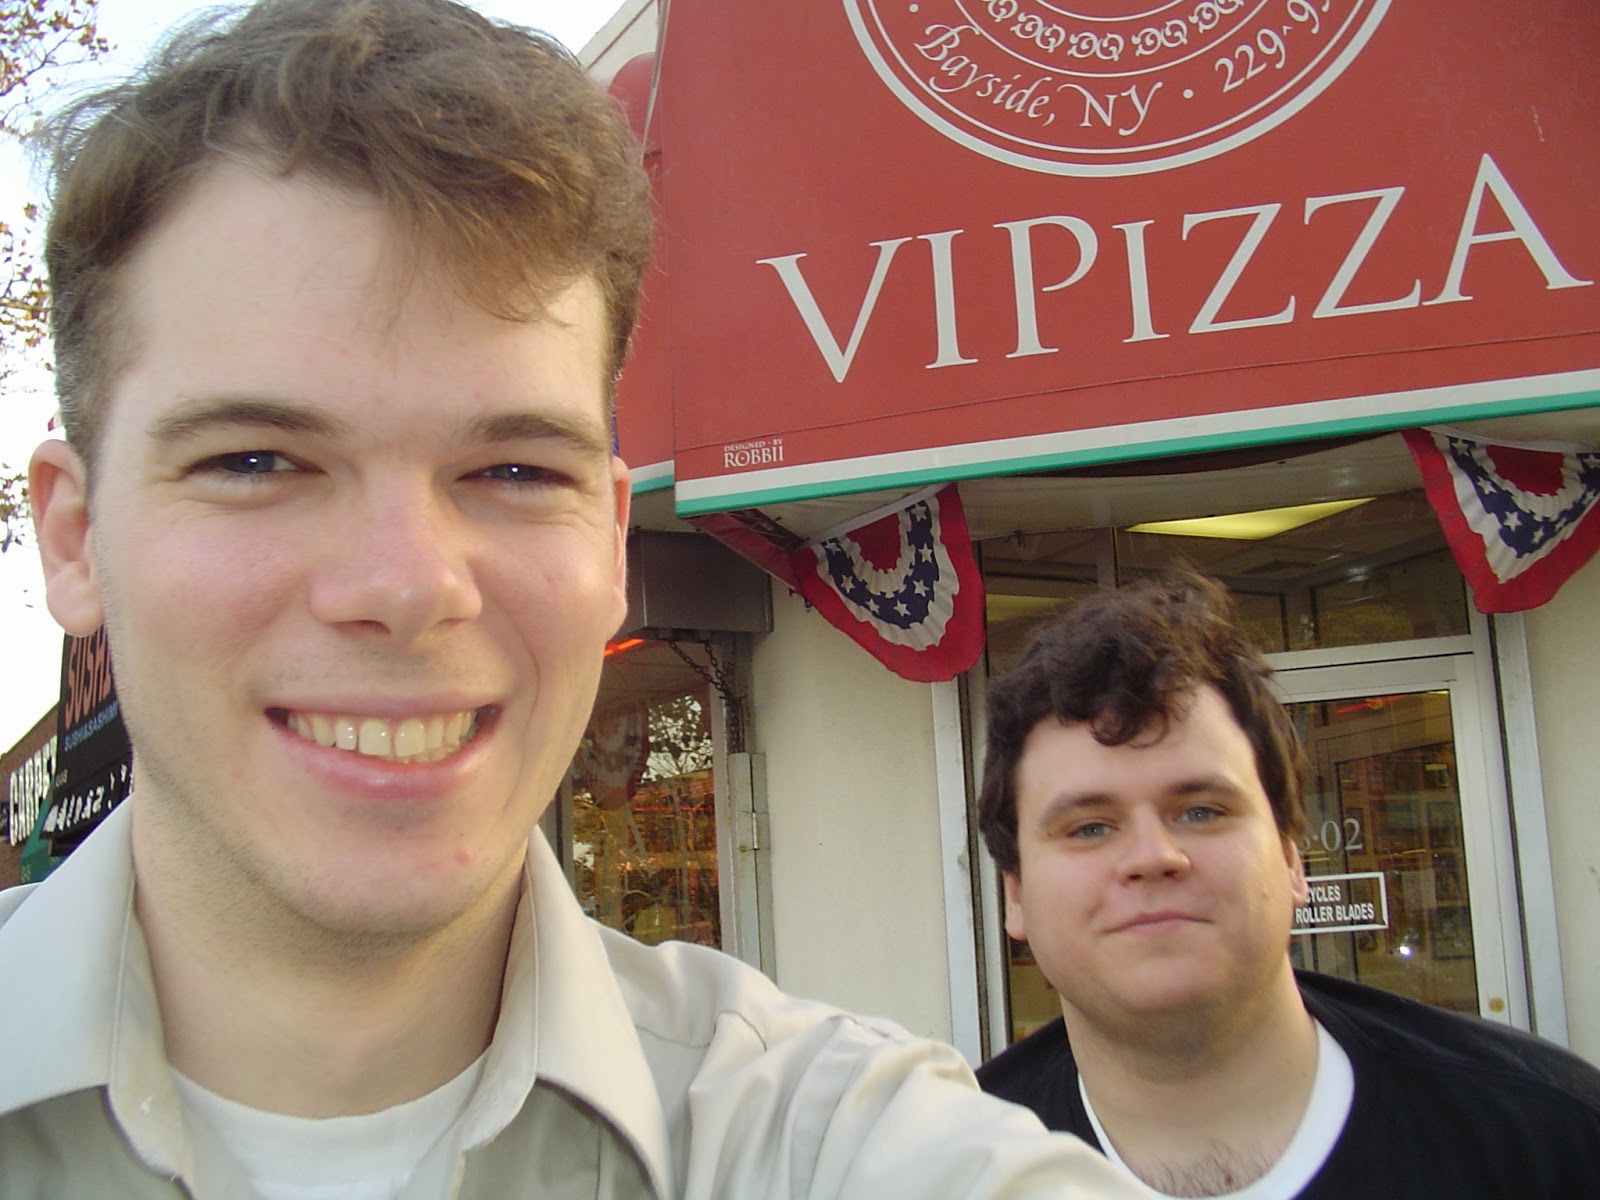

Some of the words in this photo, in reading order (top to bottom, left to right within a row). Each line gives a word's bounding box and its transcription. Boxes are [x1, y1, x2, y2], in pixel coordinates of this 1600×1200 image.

[914, 24, 1055, 127] Bayside,
[1056, 81, 1163, 136] NY
[756, 152, 1594, 383] VIPIZZA
[724, 441, 766, 452] DESIGNED
[1295, 905, 1334, 924] ROLLER
[1335, 903, 1375, 921] BLADES
